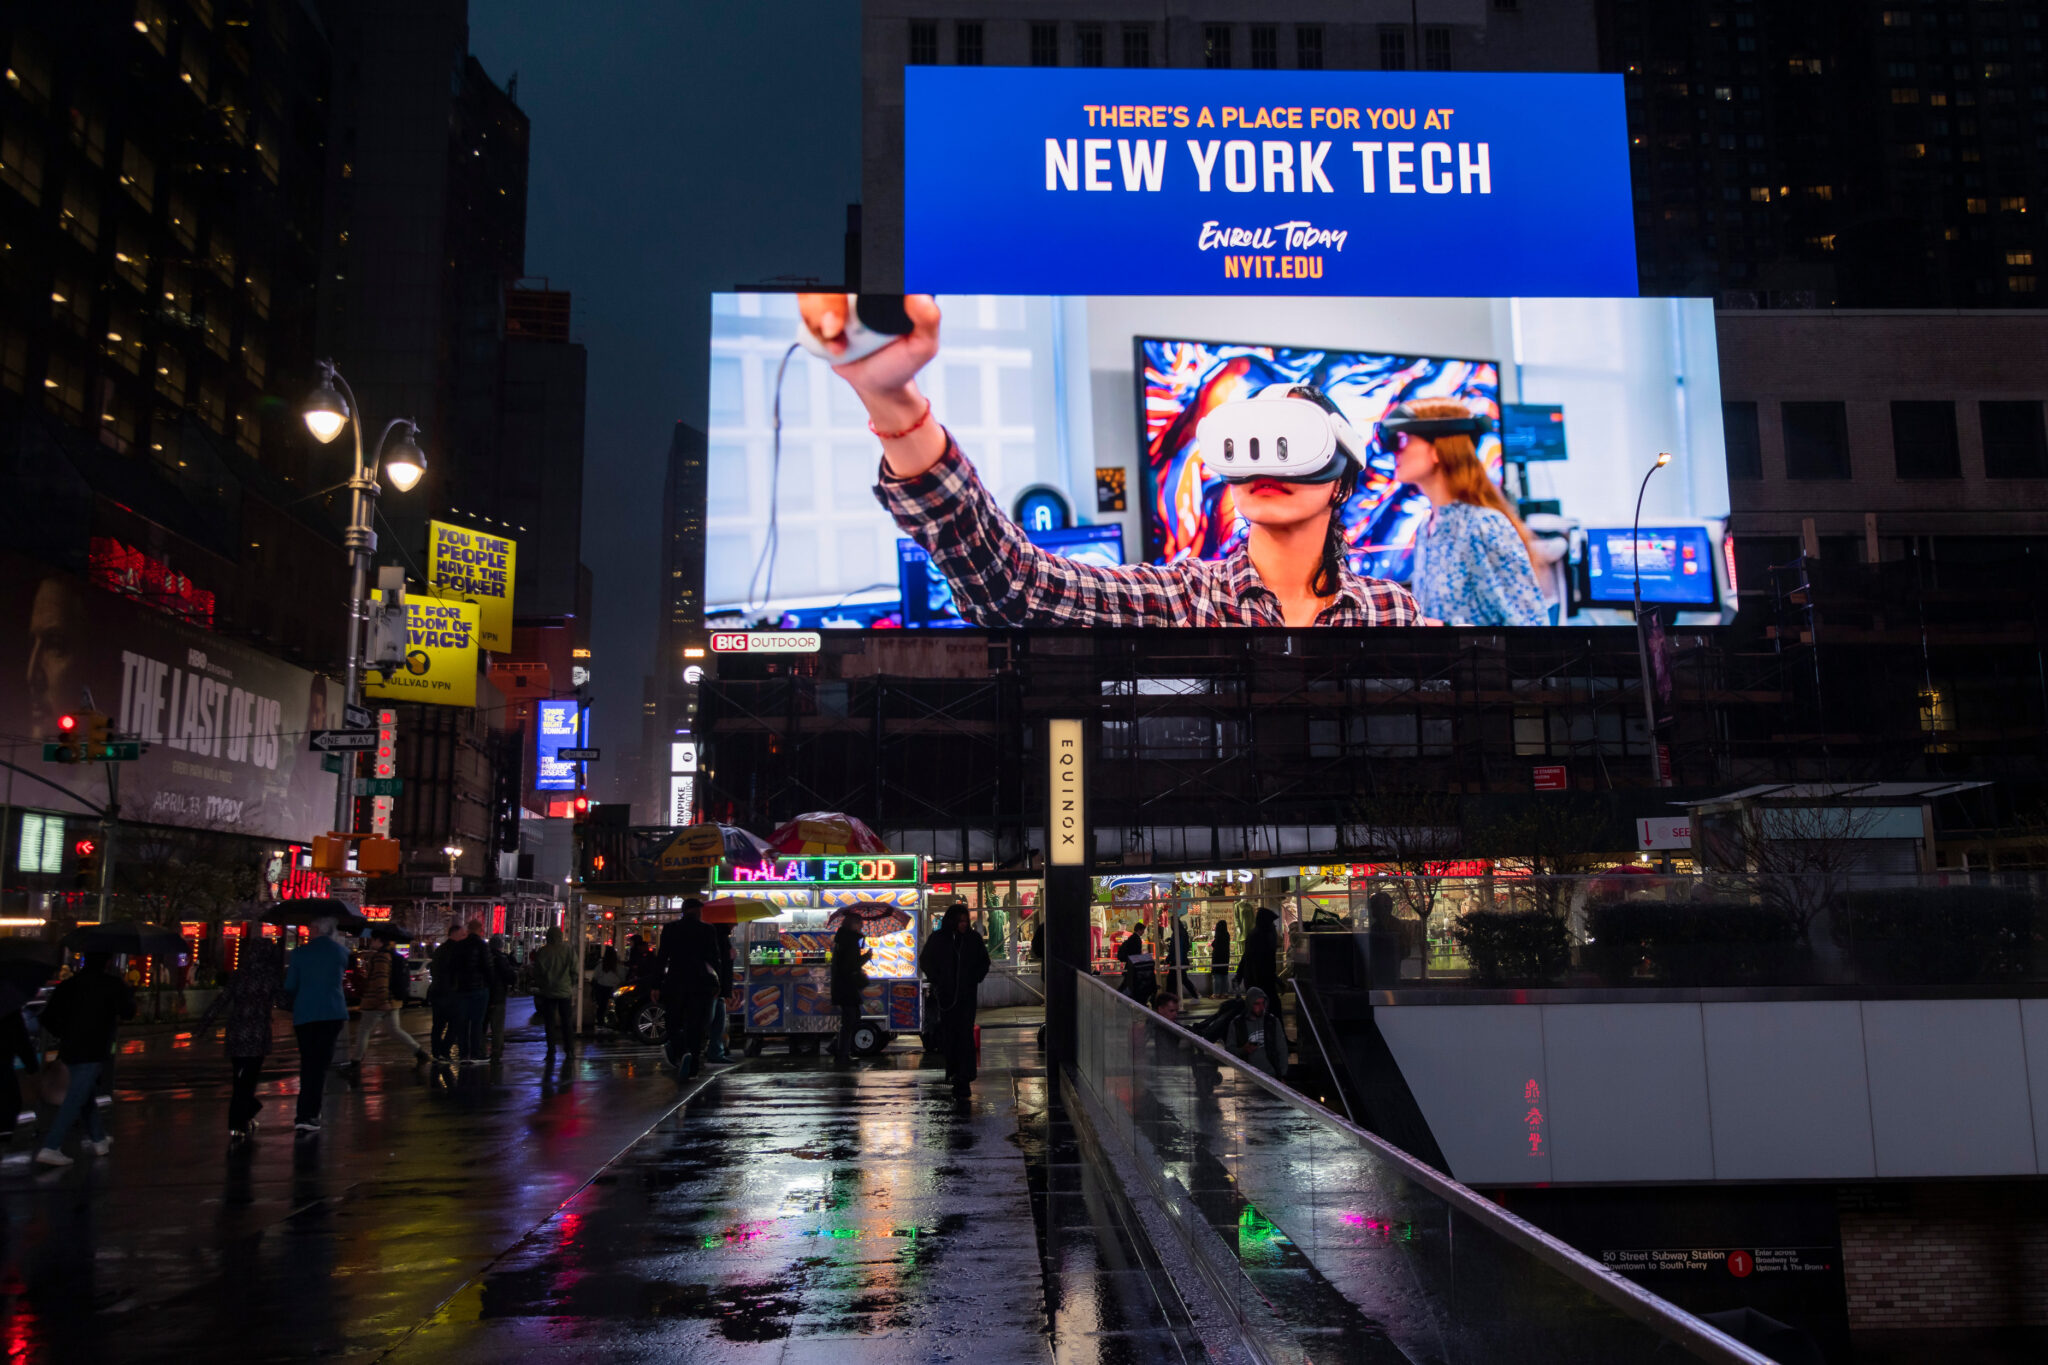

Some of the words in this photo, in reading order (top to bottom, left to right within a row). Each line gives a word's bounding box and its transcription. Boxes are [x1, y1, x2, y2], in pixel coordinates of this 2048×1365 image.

[1083, 105, 1190, 127] THERE'S
[1197, 106, 1215, 127] A
[1222, 107, 1303, 128] PLACE
[1311, 107, 1360, 129] FOR
[1367, 108, 1416, 129] YOU
[1424, 109, 1454, 129] AT
[1046, 138, 1167, 191] NEW
[1187, 140, 1334, 192] YORK
[1353, 142, 1491, 193] TECH
[1225, 255, 1323, 278] NYIT.EDU
[437, 528, 470, 546] YOU
[475, 536, 509, 555] THE
[437, 543, 507, 570] PEOPLE
[437, 560, 474, 577] HAVE
[479, 567, 507, 582] THE
[436, 573, 506, 598] POWER
[425, 606, 460, 619] FOR
[452, 621, 472, 632] OF
[482, 632, 499, 642] VPN
[716, 635, 746, 650] BIG
[751, 637, 816, 648] OUTDOOR
[188, 648, 207, 669] HBO
[431, 681, 451, 690] VPN
[119, 650, 168, 744] THE
[168, 668, 229, 758] LAST
[228, 686, 257, 763] OF
[253, 695, 281, 770] US
[320, 736, 340, 745] ONE
[350, 736, 370, 745] WAY
[1060, 739, 1075, 845] EQUINOX
[153, 791, 187, 813] APRIL
[664, 854, 719, 867] SABRETT
[824, 858, 897, 882] FOOD
[1603, 1252, 1616, 1261] 50
[1620, 1251, 1648, 1261] Street
[1652, 1250, 1688, 1264] Subway
[1692, 1250, 1725, 1260] Station
[1755, 1249, 1773, 1257] Enter
[1603, 1262, 1646, 1270] Downtown
[1648, 1262, 1657, 1270] to
[1660, 1261, 1684, 1270] South
[1686, 1260, 1708, 1271] Ferry
[1734, 1256, 1743, 1272] 1
[1756, 1264, 1781, 1272] Uptown
